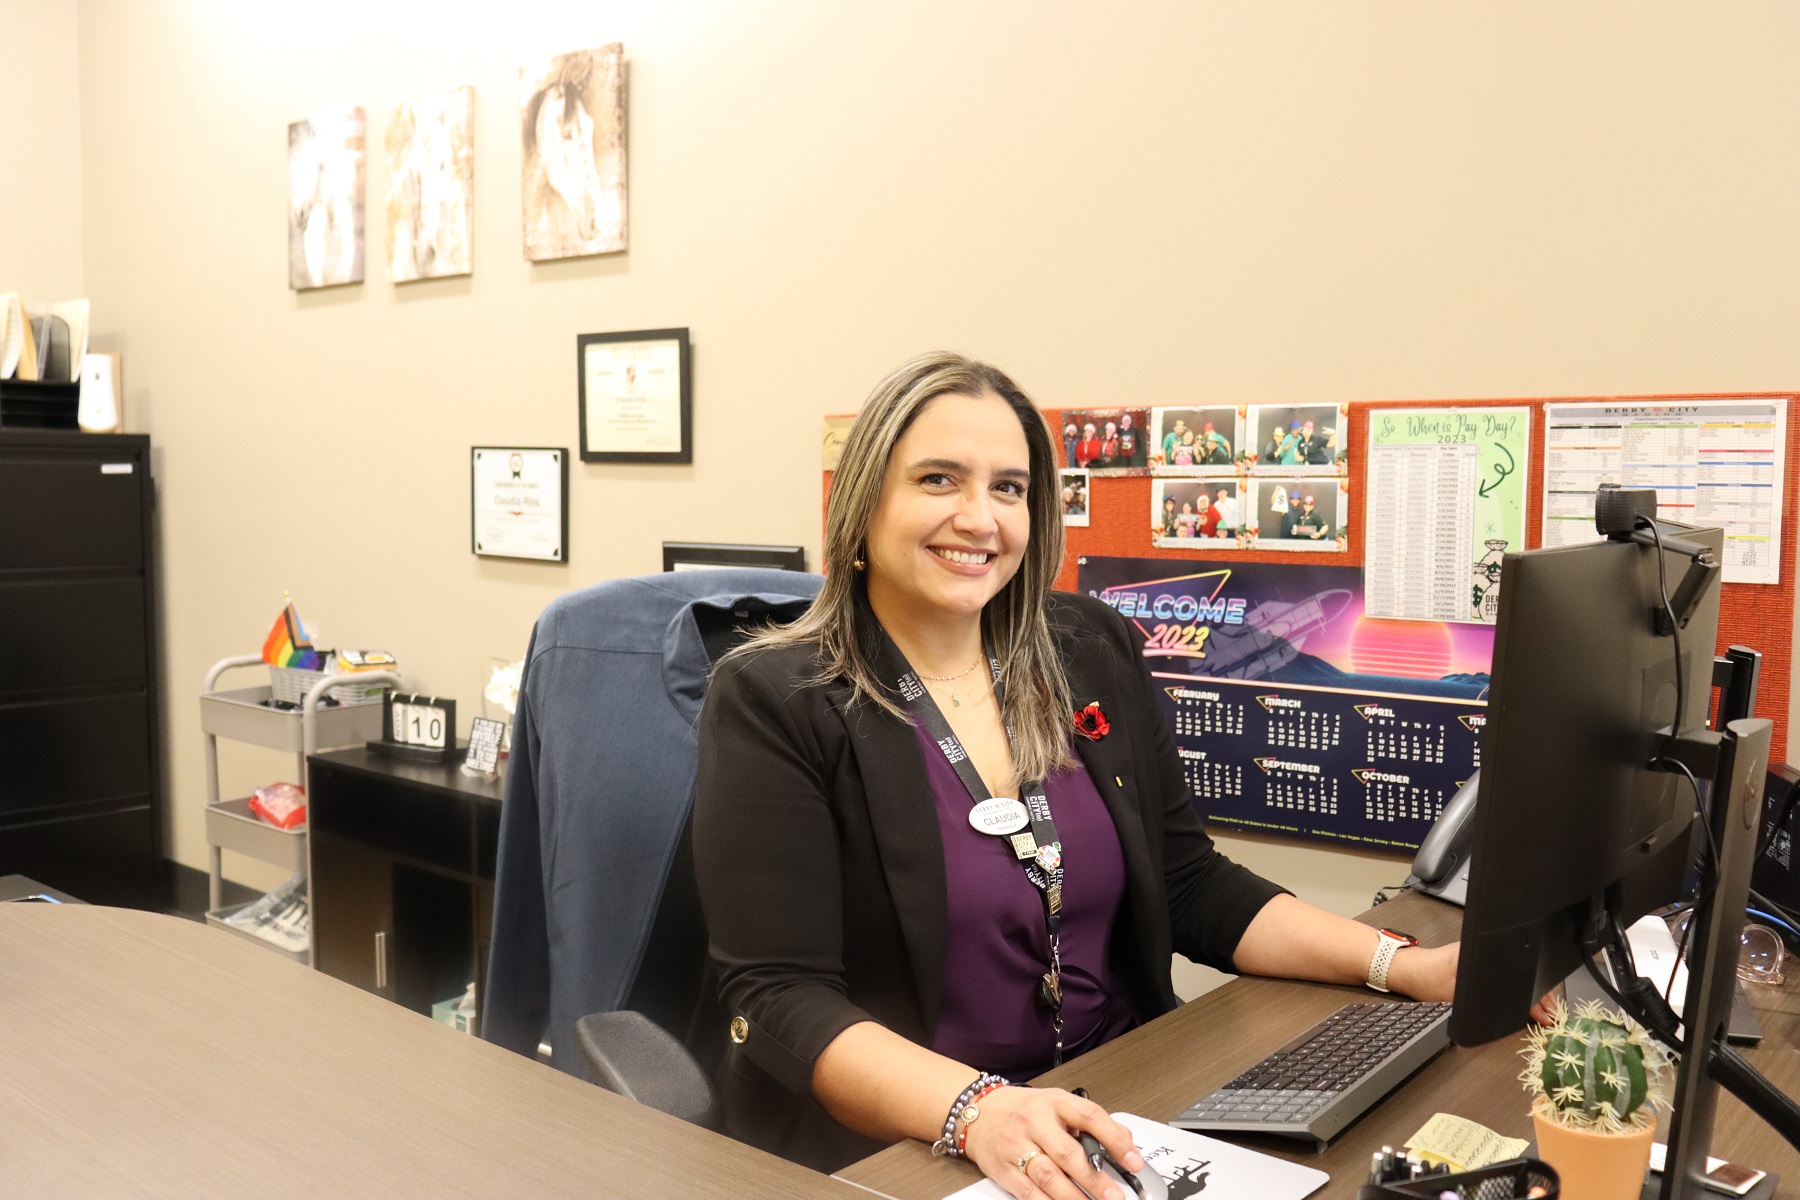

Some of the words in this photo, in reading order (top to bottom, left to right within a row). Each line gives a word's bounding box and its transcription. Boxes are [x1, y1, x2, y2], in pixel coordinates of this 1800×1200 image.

[1381, 416, 1396, 438] So
[1406, 416, 1440, 436] When
[1442, 422, 1452, 433] is
[1456, 414, 1478, 440] Pay
[1482, 414, 1516, 440] Day?
[1438, 435, 1466, 444] 2023
[494, 494, 521, 506] Claudia
[524, 496, 540, 507] Rios
[1089, 590, 1247, 624] WELCOME
[1486, 604, 1498, 612] CIT
[1144, 623, 1210, 651] 2023
[897, 678, 915, 702] DERB
[1173, 689, 1219, 701] FEBRUARY
[1264, 698, 1301, 708] MARCH
[1364, 707, 1395, 717] APRIL
[1469, 717, 1486, 726] MA
[937, 740, 958, 764] DERBY
[1178, 750, 1207, 760] UGUST
[1262, 760, 1320, 774] SEPTEMBER
[1362, 771, 1410, 784] OCTOBER
[975, 805, 993, 813] DERBY
[1038, 795, 1052, 820] DERBY
[983, 812, 1021, 826] CLAUDIA
[1143, 1146, 1175, 1161] Kee
